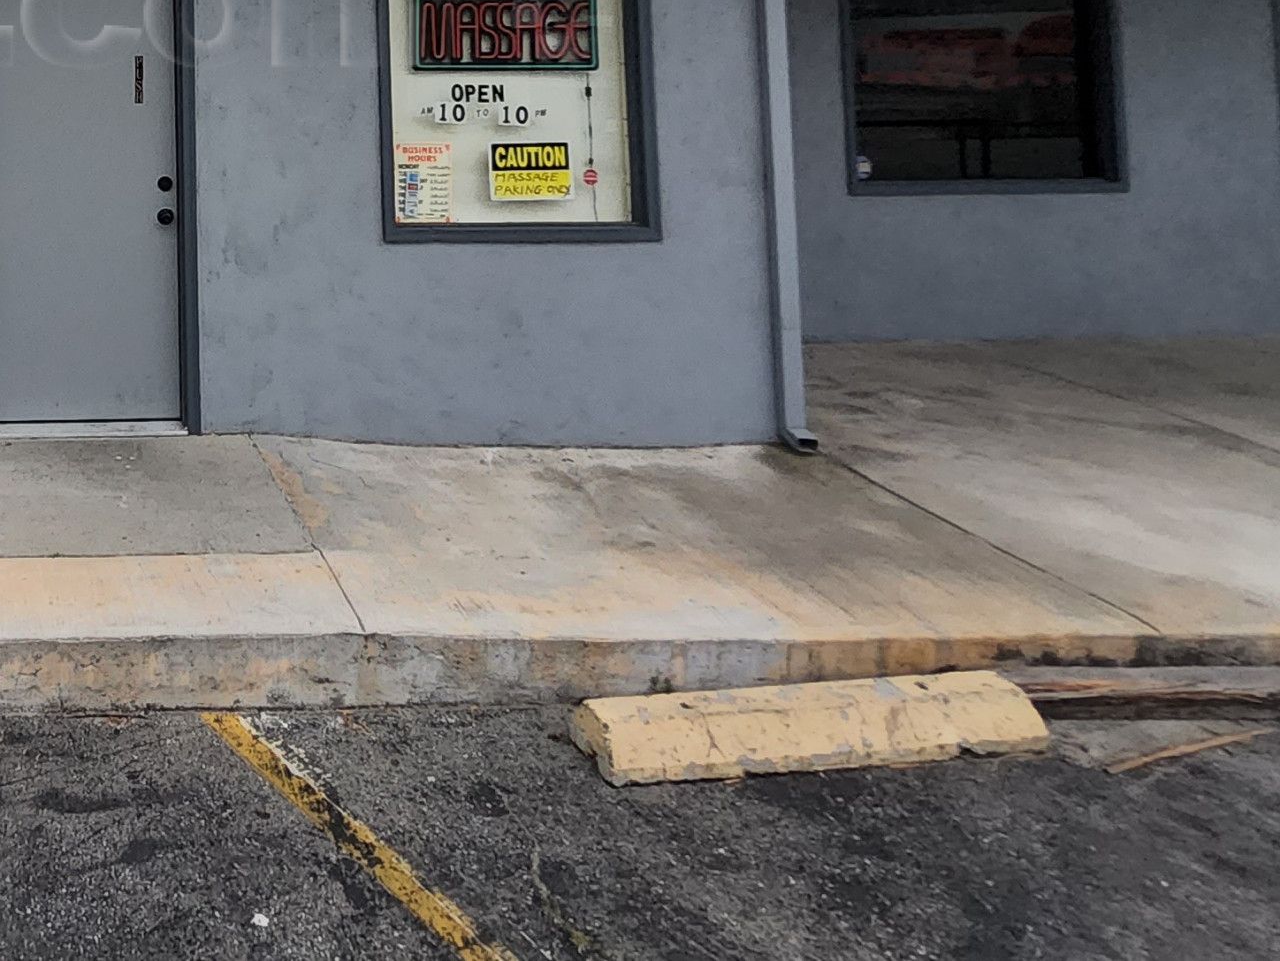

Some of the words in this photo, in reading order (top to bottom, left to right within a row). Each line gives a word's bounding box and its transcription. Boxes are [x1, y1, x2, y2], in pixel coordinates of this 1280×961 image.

[420, 2, 592, 60] MASSAGE
[451, 83, 505, 103] OPEN
[439, 103, 466, 122] 10
[476, 108, 490, 118] TO
[502, 105, 529, 125] 10
[495, 145, 567, 168] CAUTION
[494, 172, 560, 183] MASSAGE
